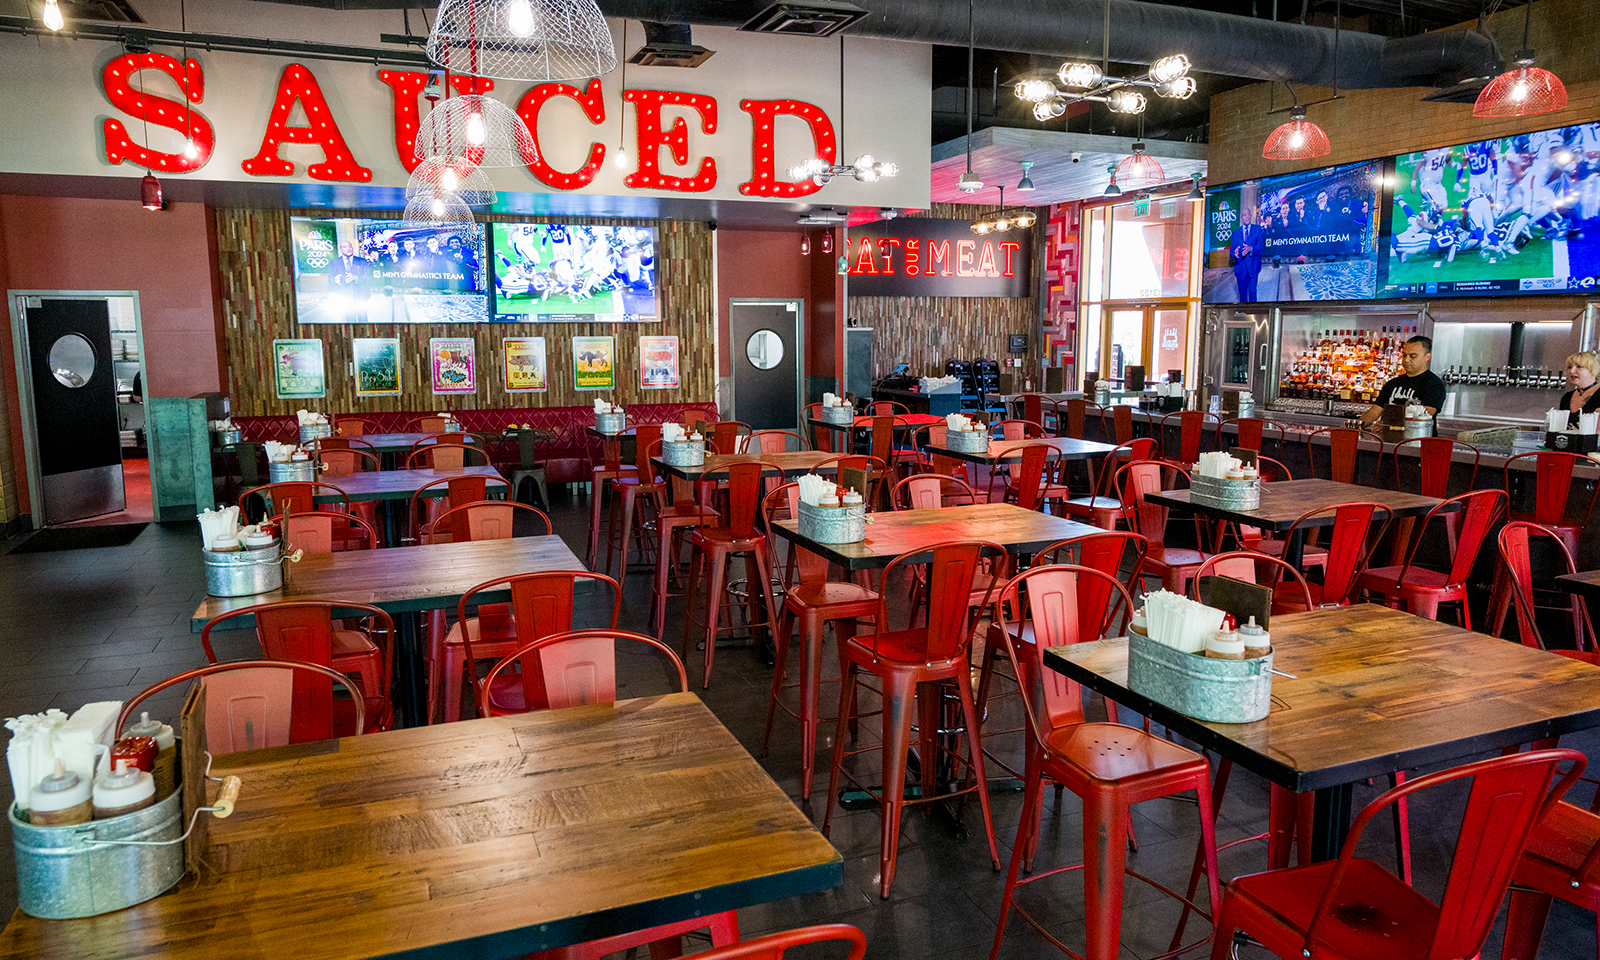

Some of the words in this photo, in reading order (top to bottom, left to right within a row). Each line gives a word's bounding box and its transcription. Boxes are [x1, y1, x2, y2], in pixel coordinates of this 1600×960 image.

[102, 52, 838, 199] SAUCED
[1211, 209, 1237, 224] PARIS
[1217, 222, 1232, 230] 2024
[298, 239, 334, 252] PARIS
[1273, 238, 1289, 246] MEN'S
[1288, 236, 1328, 246] GYMNASTICS
[1328, 233, 1350, 243] TEAM
[904, 237, 920, 277] OUR
[923, 239, 1021, 278] MEAT
[401, 272, 442, 280] GYMNASTICS
[442, 273, 465, 281] TEAM
[651, 368, 670, 376] IPA
